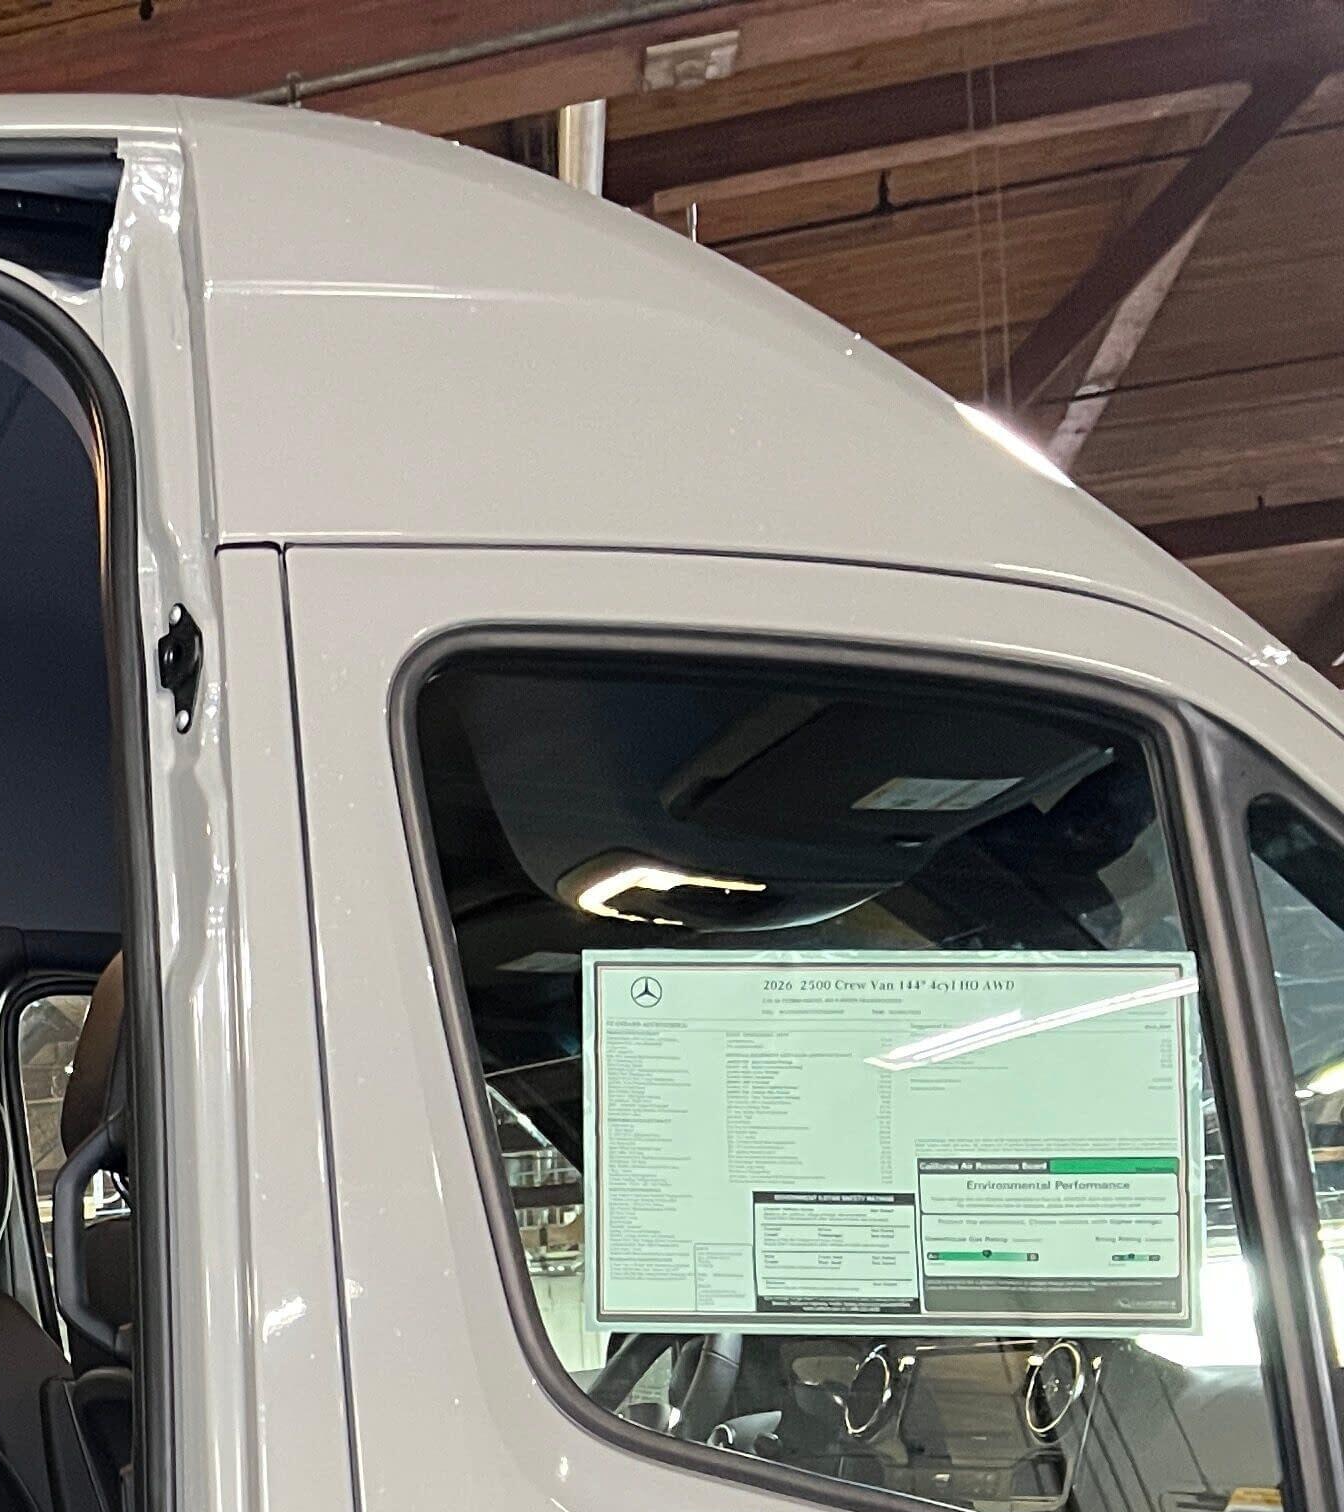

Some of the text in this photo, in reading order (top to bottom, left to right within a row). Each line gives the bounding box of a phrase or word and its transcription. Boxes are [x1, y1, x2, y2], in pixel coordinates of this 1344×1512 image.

[763, 980, 793, 991] 2026
[800, 980, 831, 991] 2500
[835, 980, 866, 991] Crew
[871, 980, 894, 991] Van
[983, 980, 1015, 991] AWD
[919, 1162, 959, 1170] California
[966, 1180, 1130, 1190] Environmental Performance
